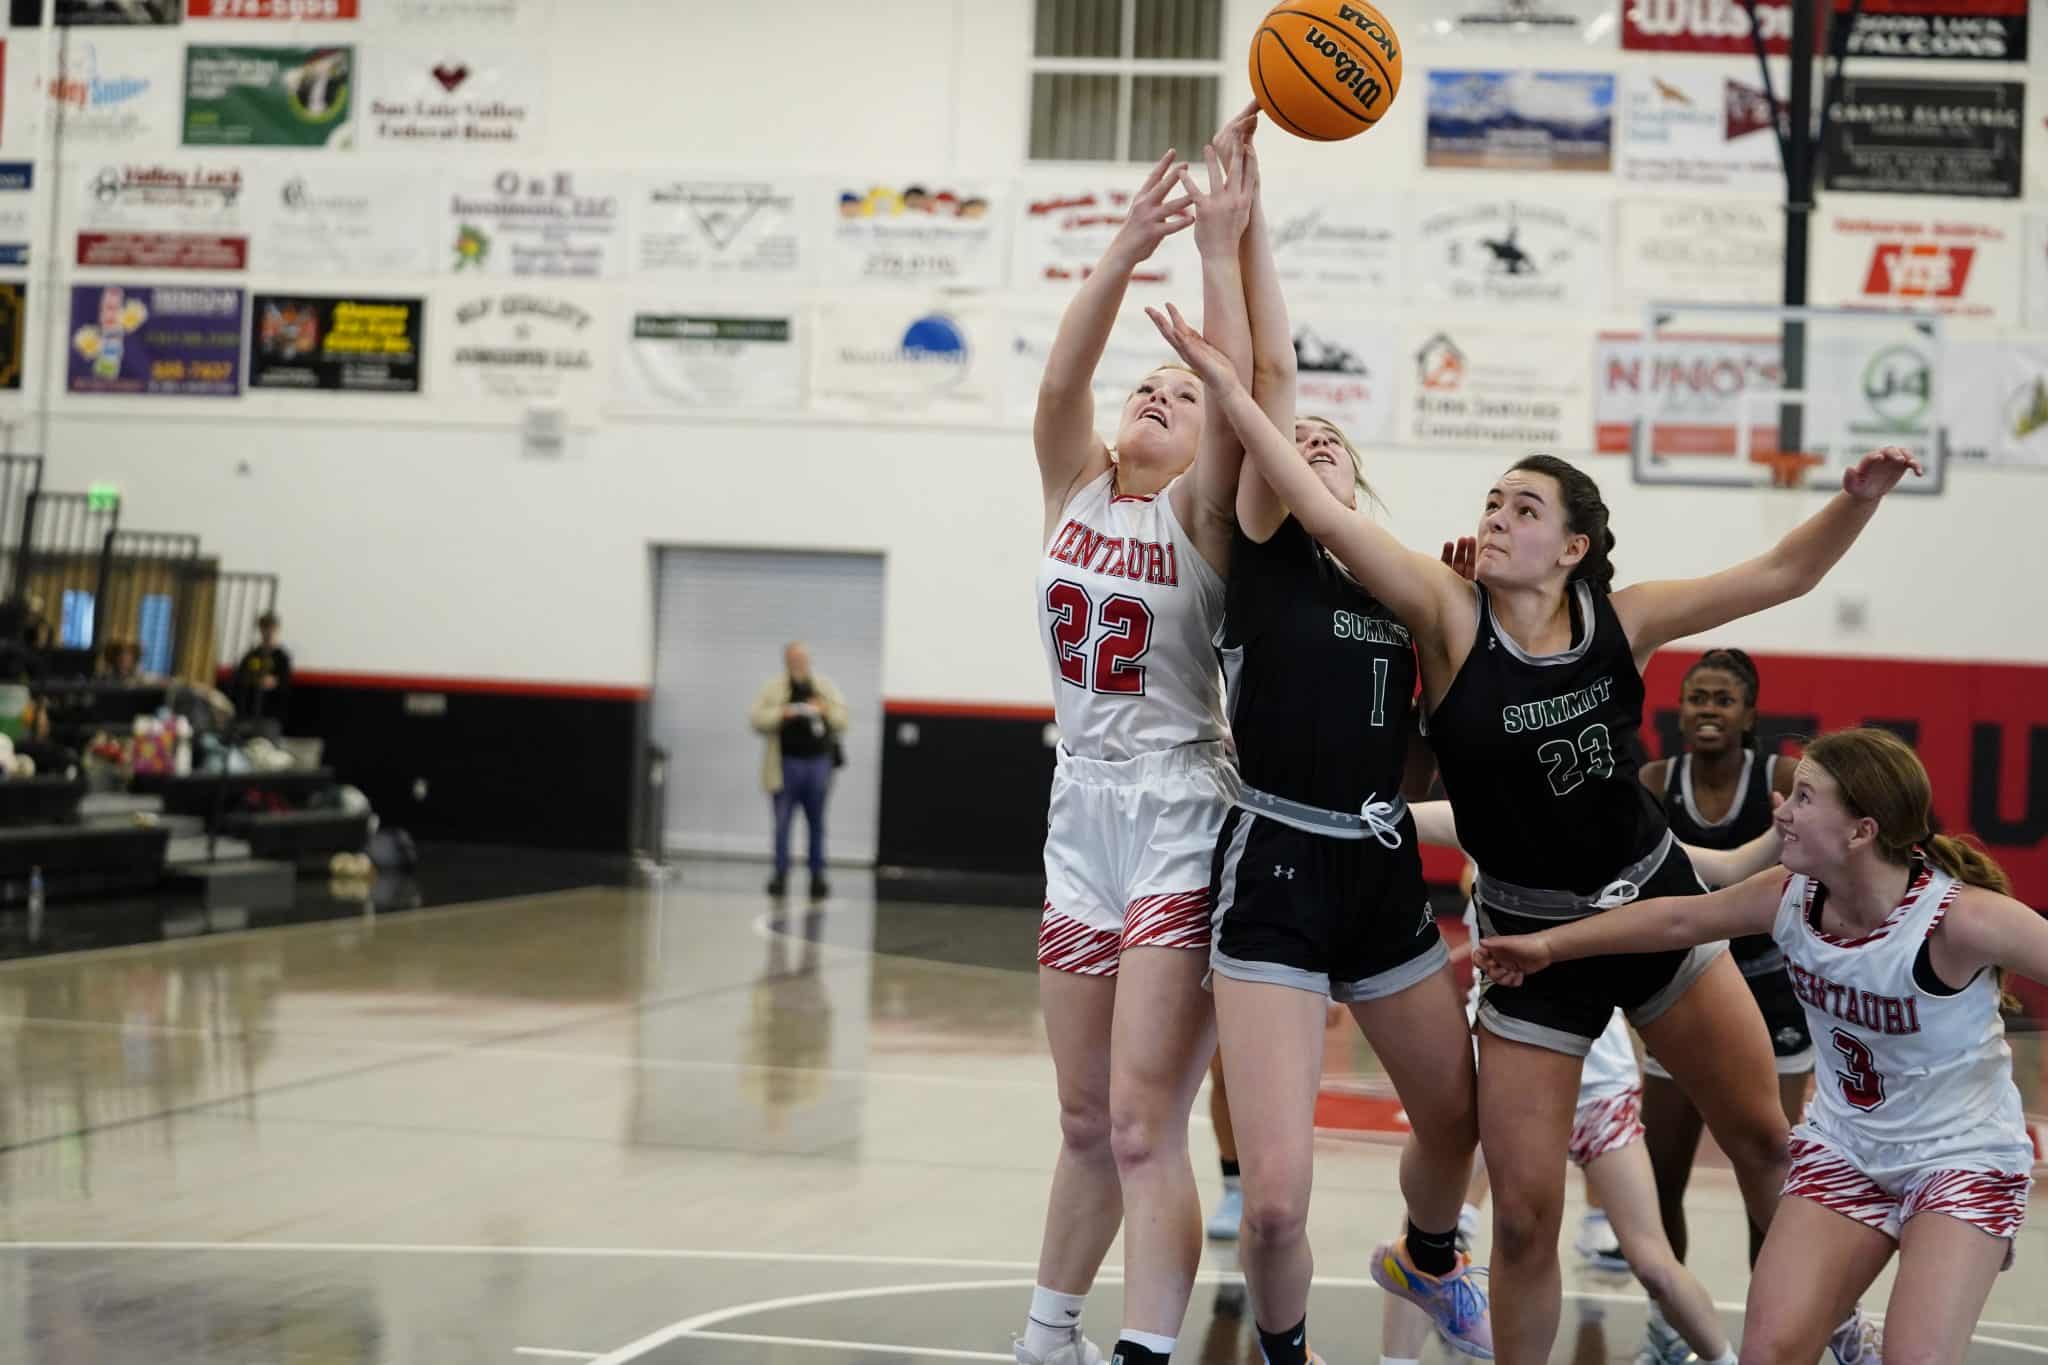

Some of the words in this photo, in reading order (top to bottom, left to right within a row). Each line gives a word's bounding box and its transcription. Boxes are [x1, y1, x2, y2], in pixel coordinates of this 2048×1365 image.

[1305, 25, 1382, 111] Wilson
[1339, 4, 1398, 62] NCAA
[1847, 33, 2007, 56] FALCONS
[1049, 518, 1178, 587] CENTAURI
[1046, 578, 1154, 696] 22
[1370, 657, 1388, 726] 1
[1502, 675, 1613, 733] SUMMIT
[1536, 723, 1615, 796] 23
[1783, 953, 1922, 1036] CENTAURI
[1829, 1026, 1887, 1114] 3
